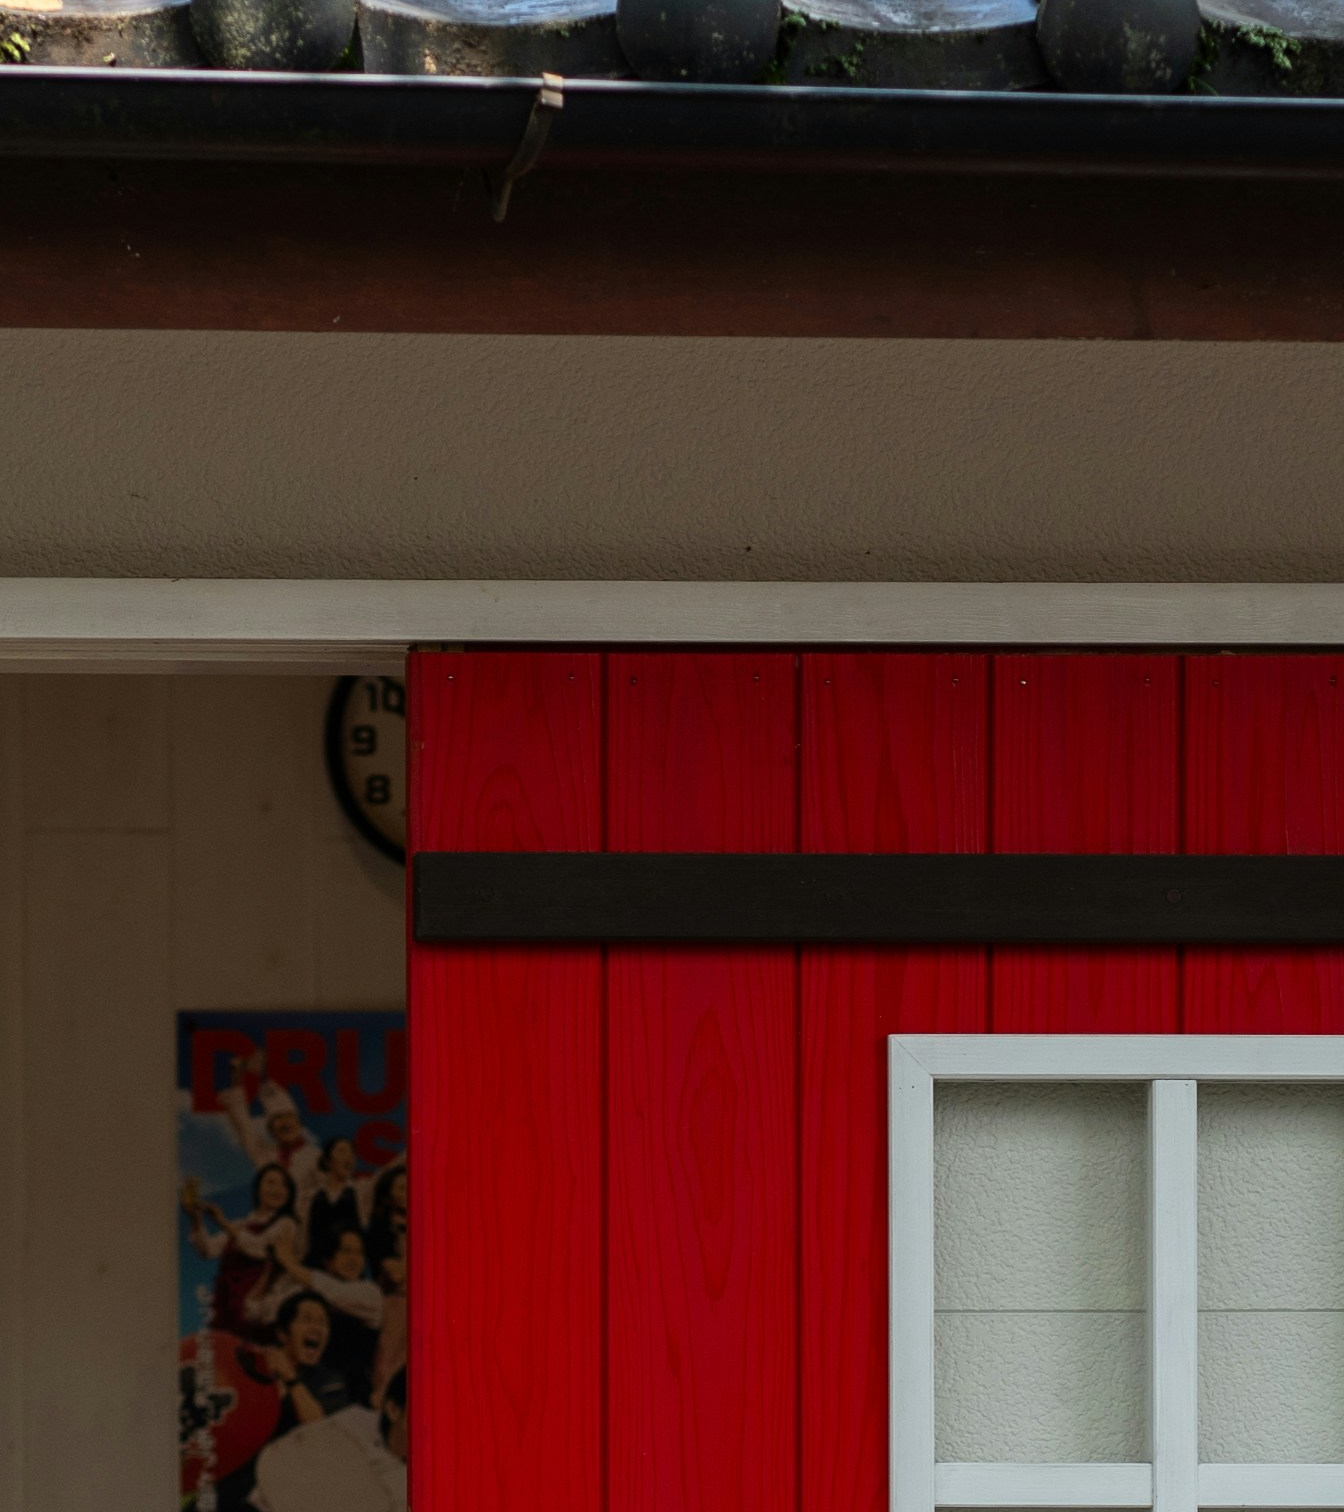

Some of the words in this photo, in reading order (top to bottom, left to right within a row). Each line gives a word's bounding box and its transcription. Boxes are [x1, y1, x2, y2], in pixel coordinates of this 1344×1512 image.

[365, 682, 405, 712] 10
[352, 725, 376, 755] 9
[366, 774, 391, 804] 8
